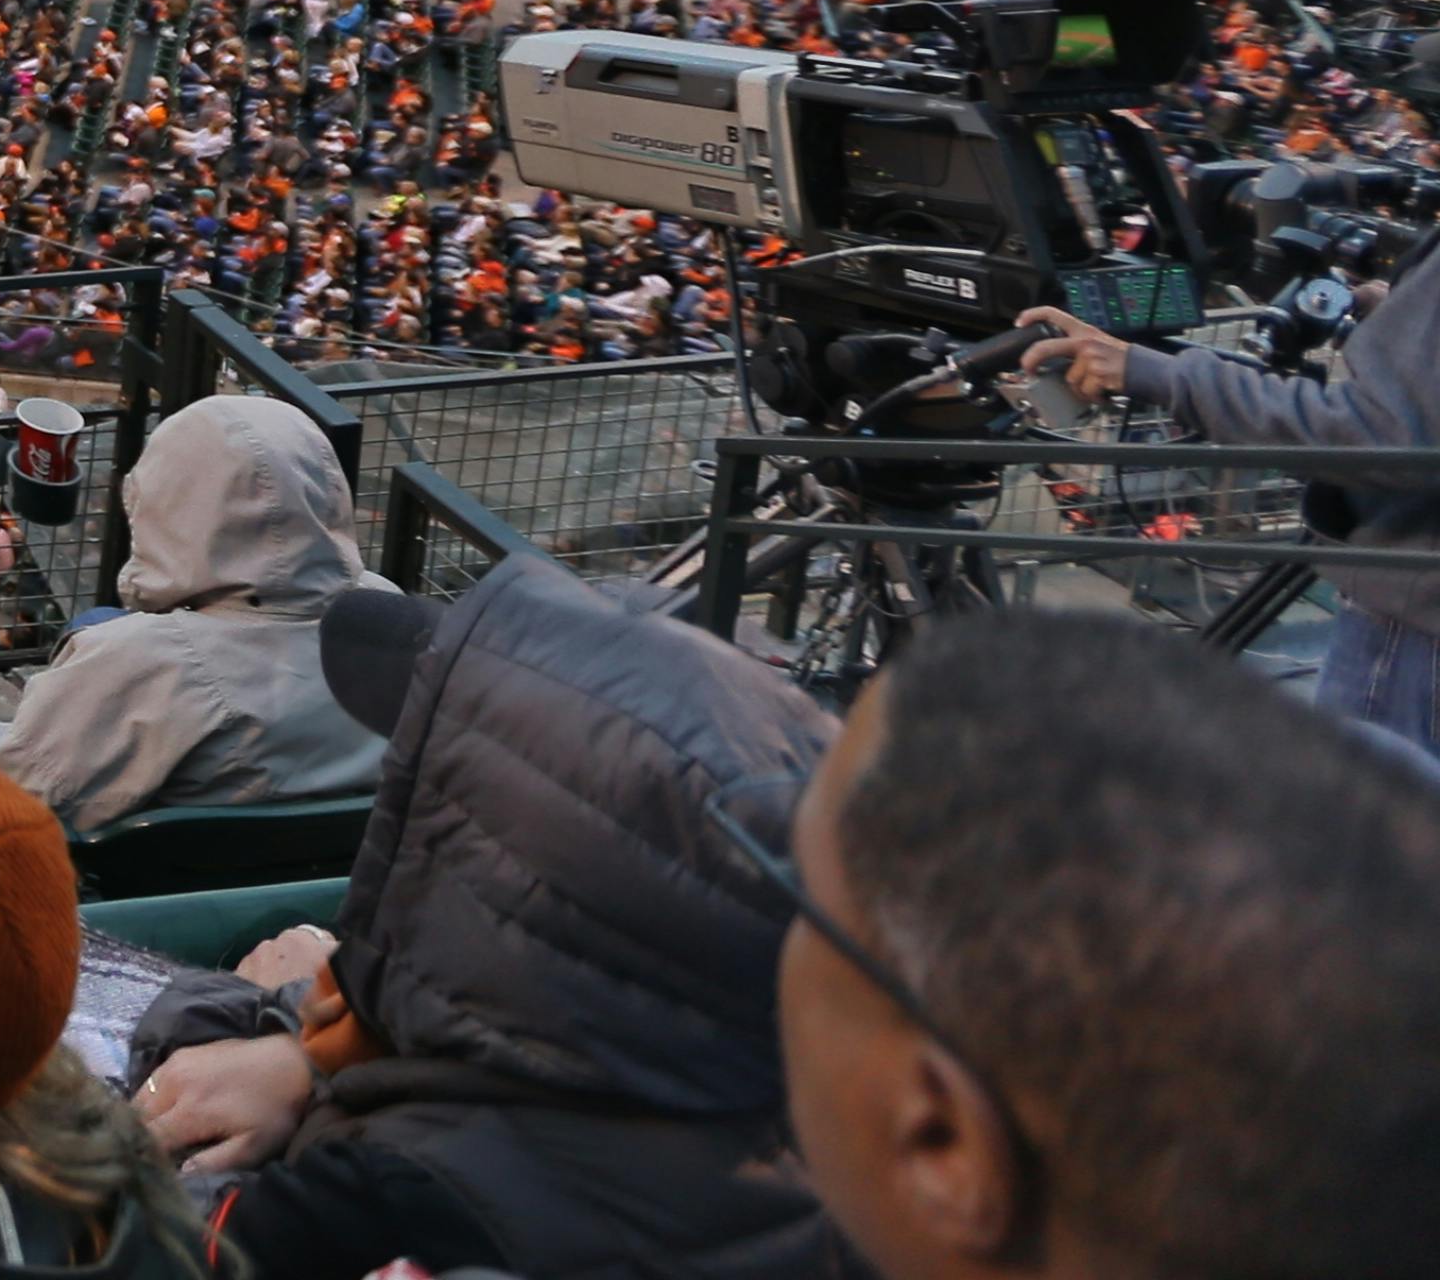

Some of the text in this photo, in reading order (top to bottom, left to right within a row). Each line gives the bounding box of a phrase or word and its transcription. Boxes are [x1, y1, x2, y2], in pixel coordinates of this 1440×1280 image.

[726, 125, 739, 143] B
[700, 142, 737, 167] 88
[903, 268, 978, 300] REFLEX B
[844, 400, 862, 422] B
